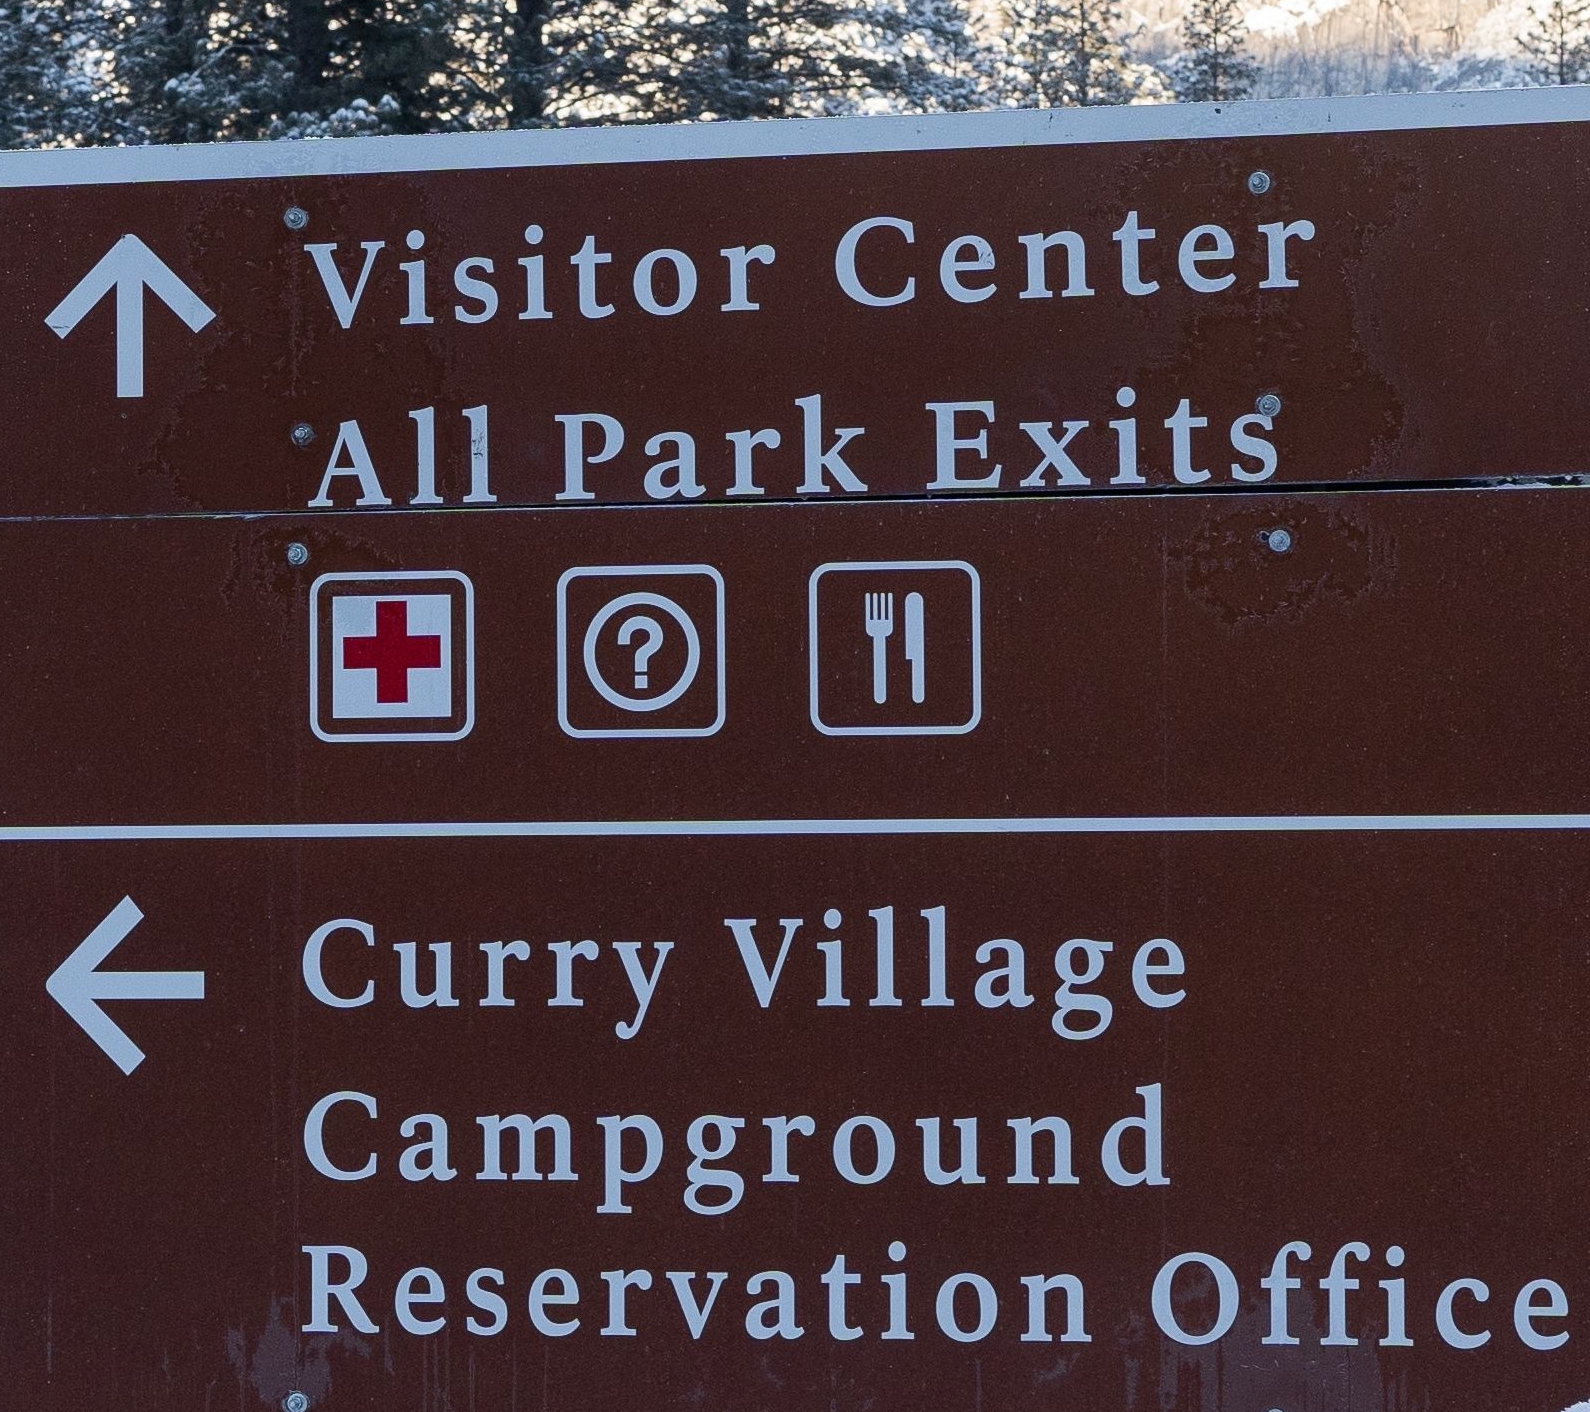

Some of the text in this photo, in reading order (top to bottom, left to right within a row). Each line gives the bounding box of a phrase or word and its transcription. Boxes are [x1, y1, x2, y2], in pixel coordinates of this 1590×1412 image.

[304, 211, 1315, 328] Visitor Center
[308, 387, 1280, 507] All Park Exits
[303, 906, 1186, 1040] Curry Village
[304, 1083, 1170, 1215] Campground
[302, 1241, 1569, 1350] Reservation Office
